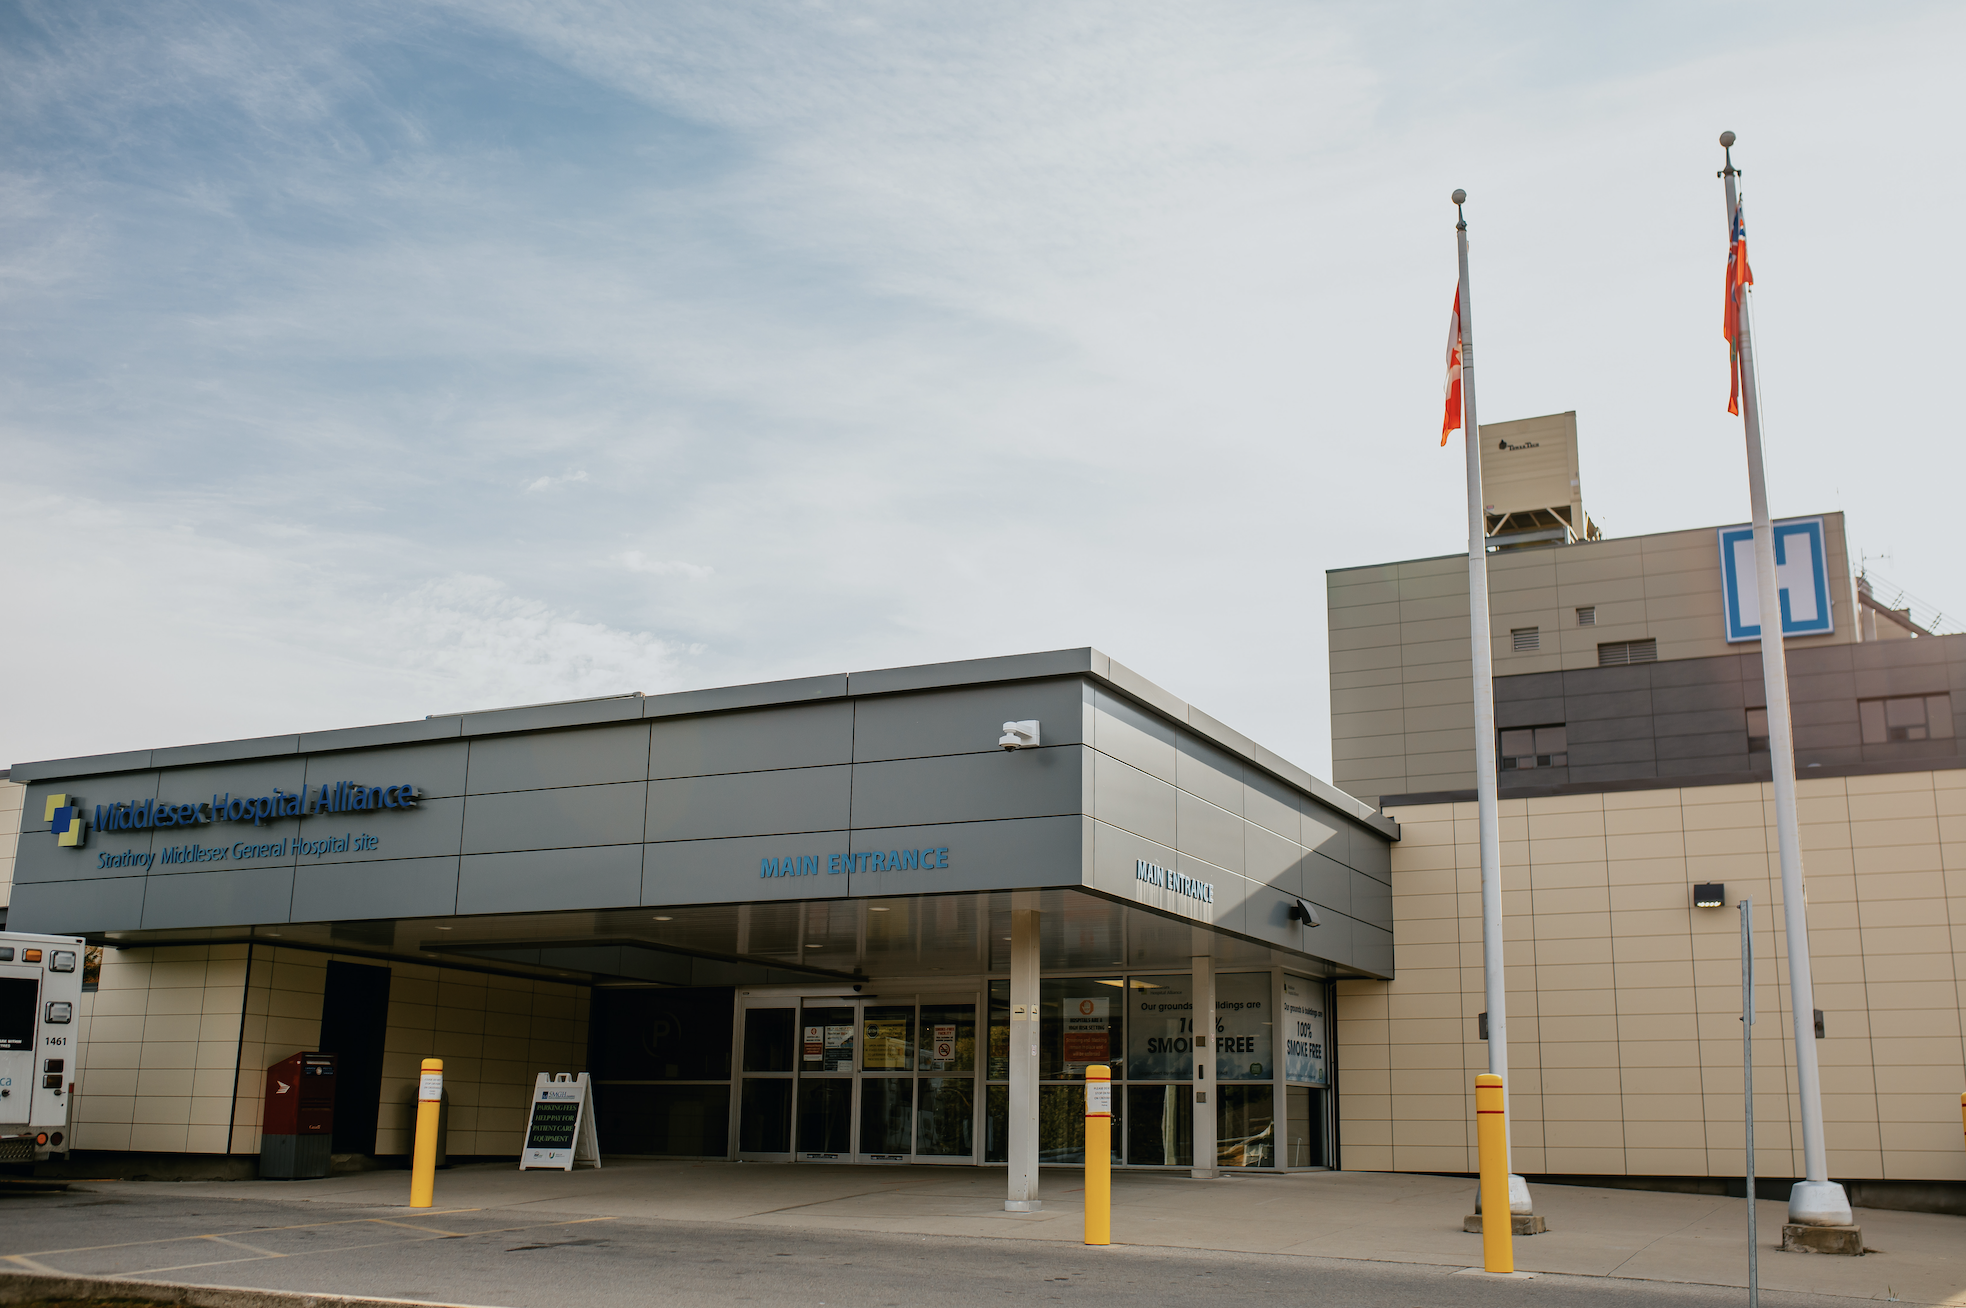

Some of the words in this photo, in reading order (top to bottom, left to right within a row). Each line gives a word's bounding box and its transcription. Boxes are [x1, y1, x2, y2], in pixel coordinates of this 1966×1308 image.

[1733, 532, 1818, 628] H
[92, 798, 206, 832] Middlesex
[211, 784, 308, 827] Hospital
[314, 781, 414, 814] Alliance
[97, 849, 156, 872] Strathroy
[160, 844, 229, 865] Middlesex
[232, 837, 287, 860] General
[291, 833, 350, 859] Hospital
[354, 833, 379, 852] site
[760, 855, 819, 879] MAIN
[827, 847, 949, 875] ENTRANCE
[1136, 858, 1164, 888] MAIN
[1166, 868, 1214, 904] ENTRANCE
[1141, 1002, 1156, 1011] Our
[1158, 1002, 1193, 1012] grounds
[1215, 1001, 1244, 1012] ildings
[1246, 1001, 1261, 1009] are
[45, 1036, 67, 1046] 1461
[1297, 1021, 1312, 1038] 100%
[1147, 1037, 1193, 1053] SMO
[1216, 1036, 1254, 1053] FREE
[1287, 1039, 1308, 1057] SMOKE
[1309, 1042, 1322, 1059] FREE
